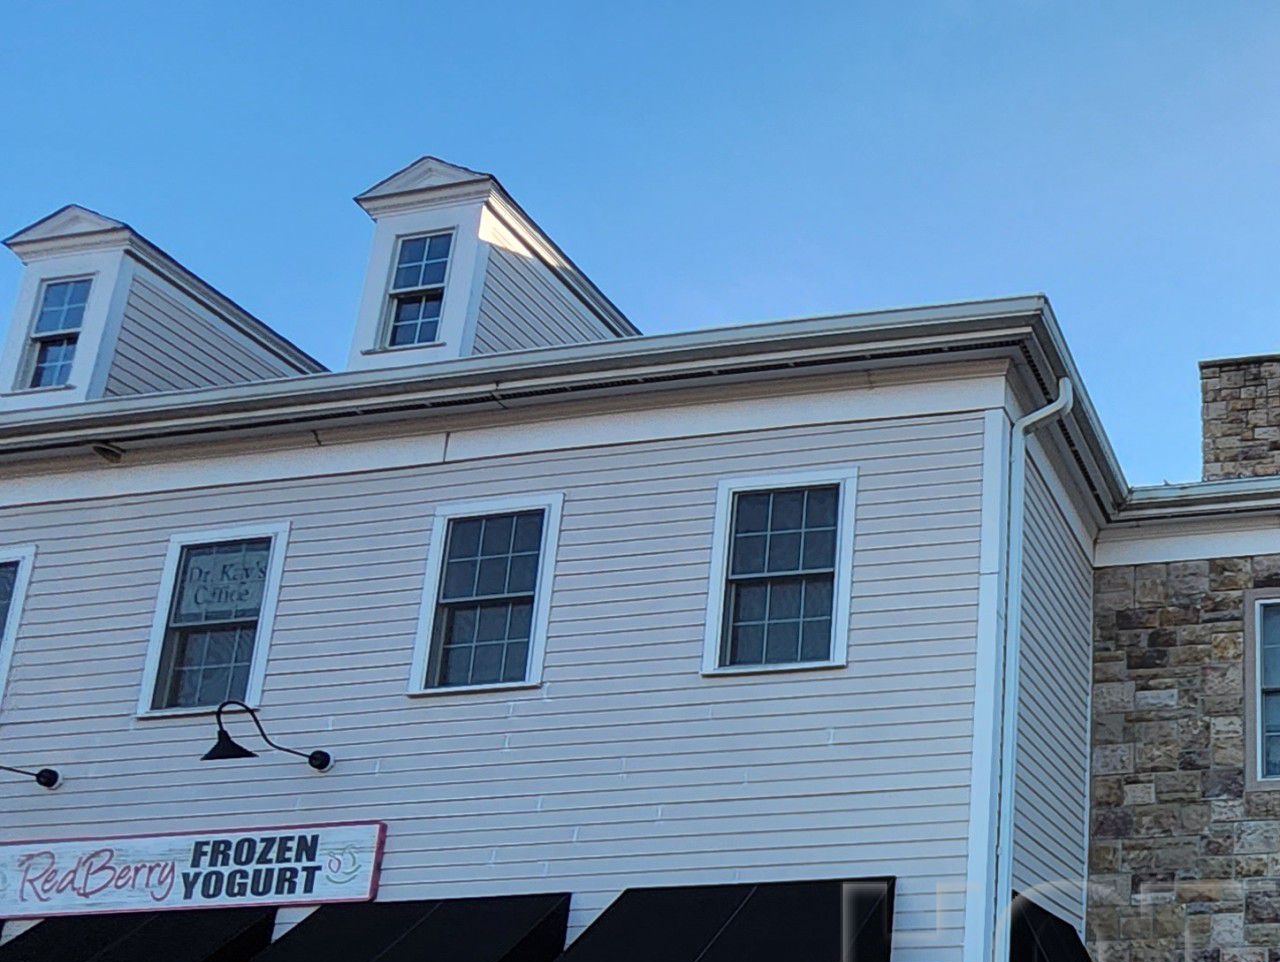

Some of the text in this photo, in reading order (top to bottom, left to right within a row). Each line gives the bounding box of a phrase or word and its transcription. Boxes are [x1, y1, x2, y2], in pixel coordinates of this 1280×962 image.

[190, 834, 319, 868] FROZEN
[18, 848, 175, 902] RedBerry
[181, 865, 322, 900] YOGURT
